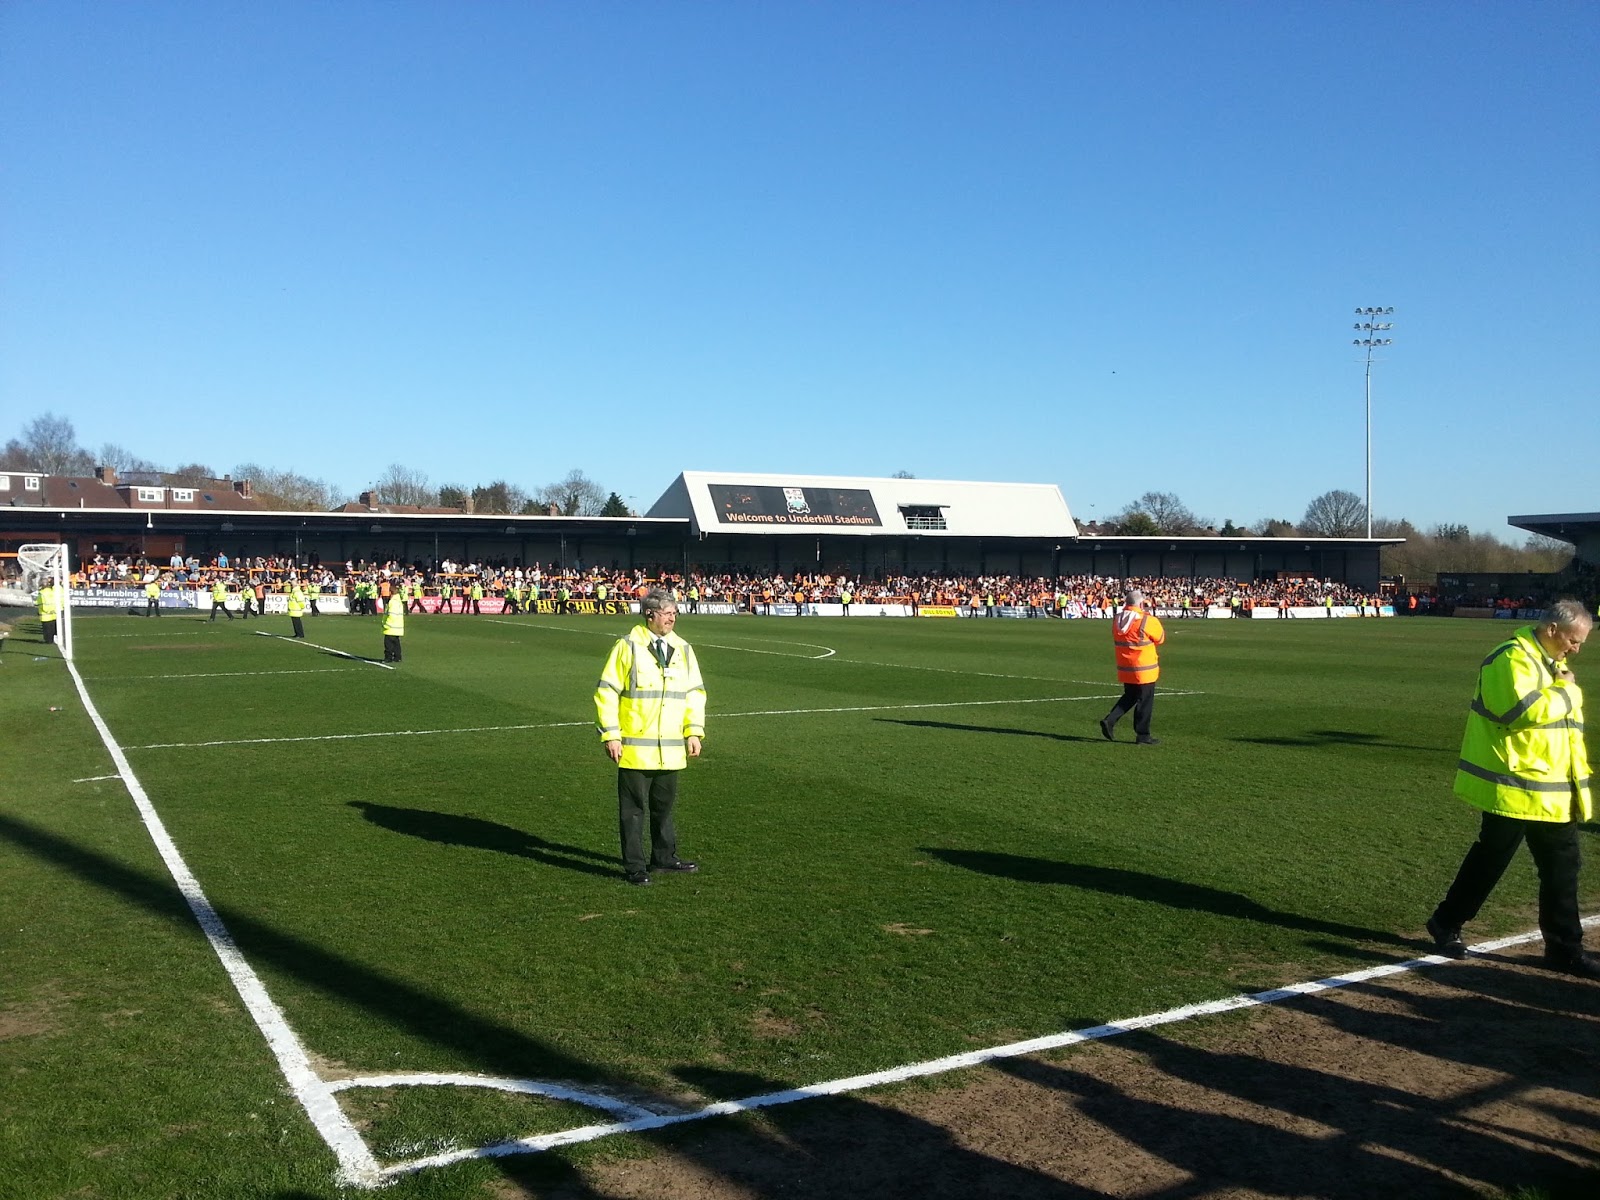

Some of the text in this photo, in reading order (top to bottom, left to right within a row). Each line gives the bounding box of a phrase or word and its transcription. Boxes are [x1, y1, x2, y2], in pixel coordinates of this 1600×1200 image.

[726, 512, 875, 526] Welcome to Underhill Stadium
[96, 590, 139, 599] Plumbing
[700, 603, 709, 614] OF
